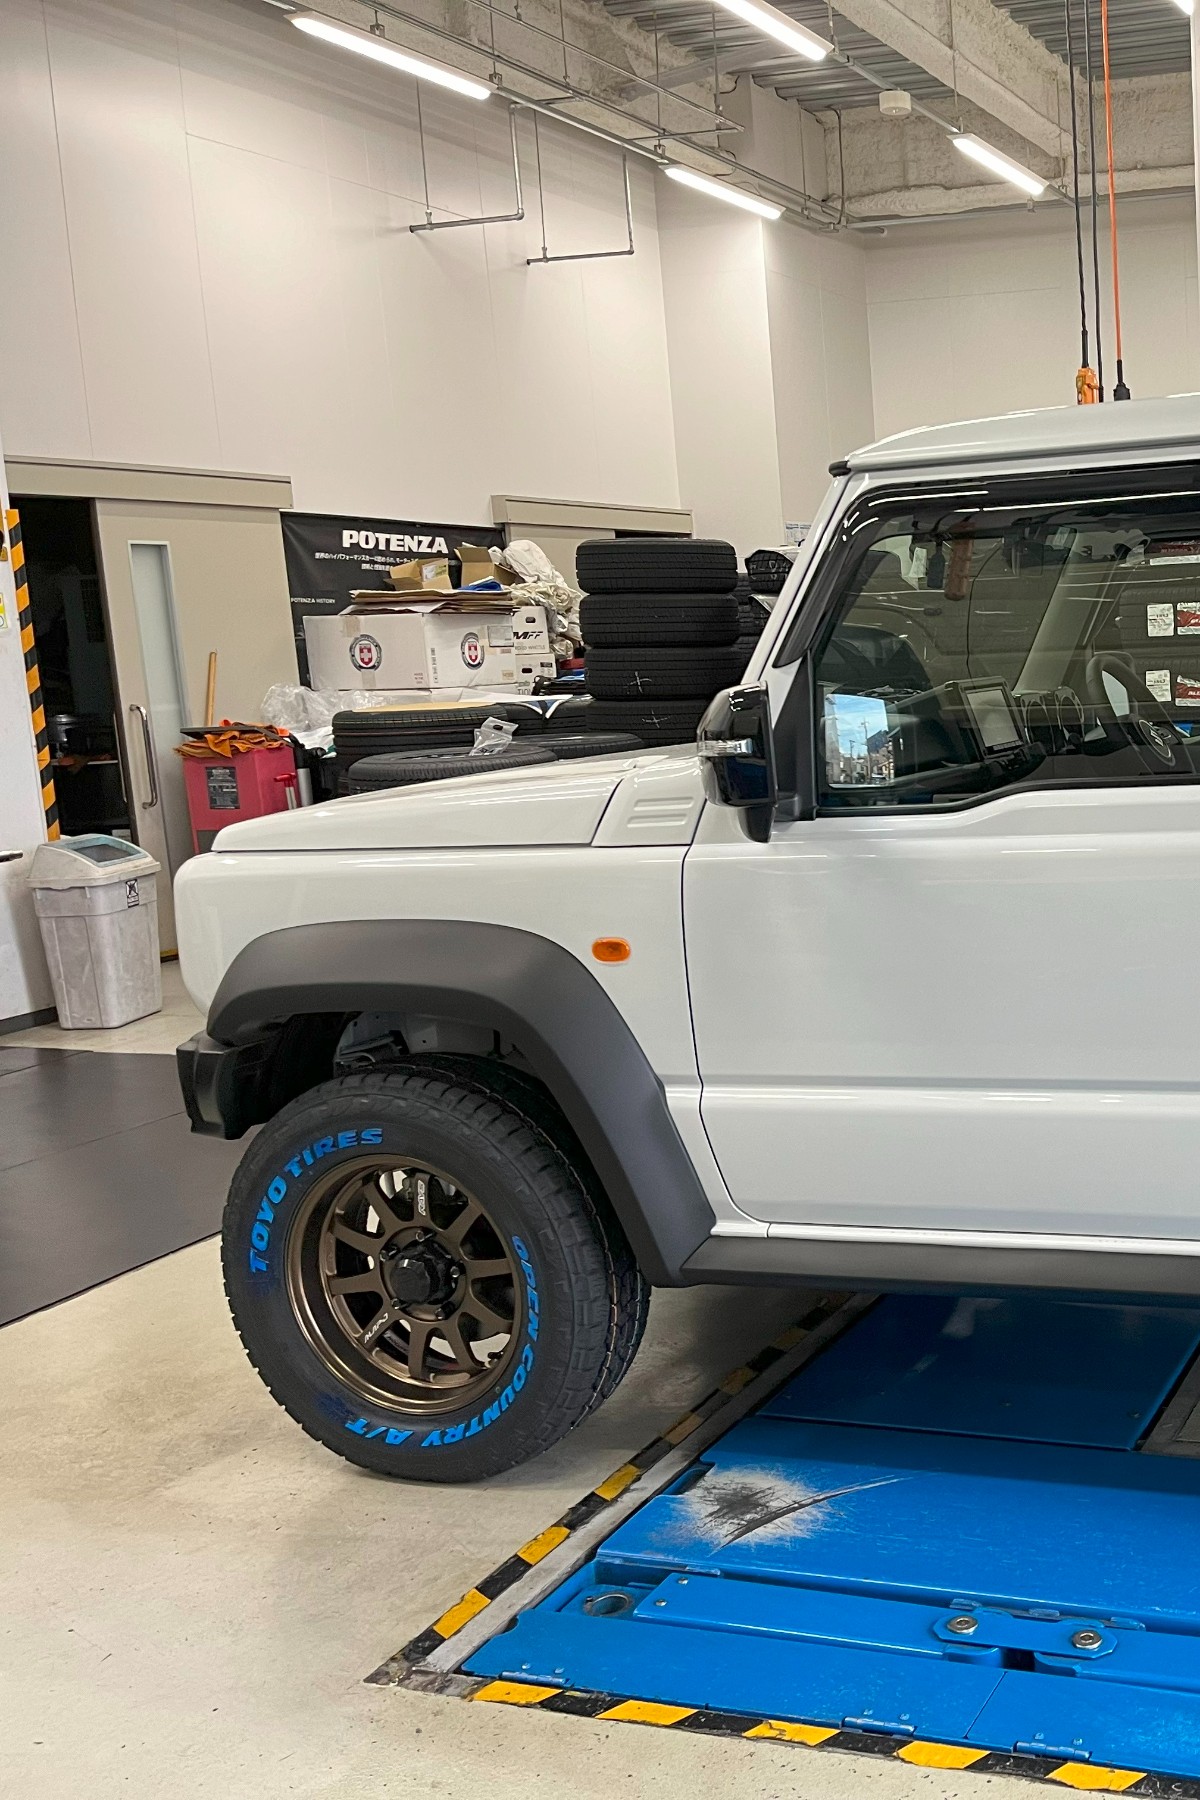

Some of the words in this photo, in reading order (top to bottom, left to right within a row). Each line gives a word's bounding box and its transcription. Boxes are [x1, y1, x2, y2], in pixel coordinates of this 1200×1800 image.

[342, 530, 448, 554] POTENZA
[250, 1175, 287, 1274] TOYO
[284, 1128, 383, 1178] TIRES
[512, 1235, 539, 1342] OPEN
[345, 1417, 414, 1445] A/T
[421, 1343, 534, 1447] COUNTRY
